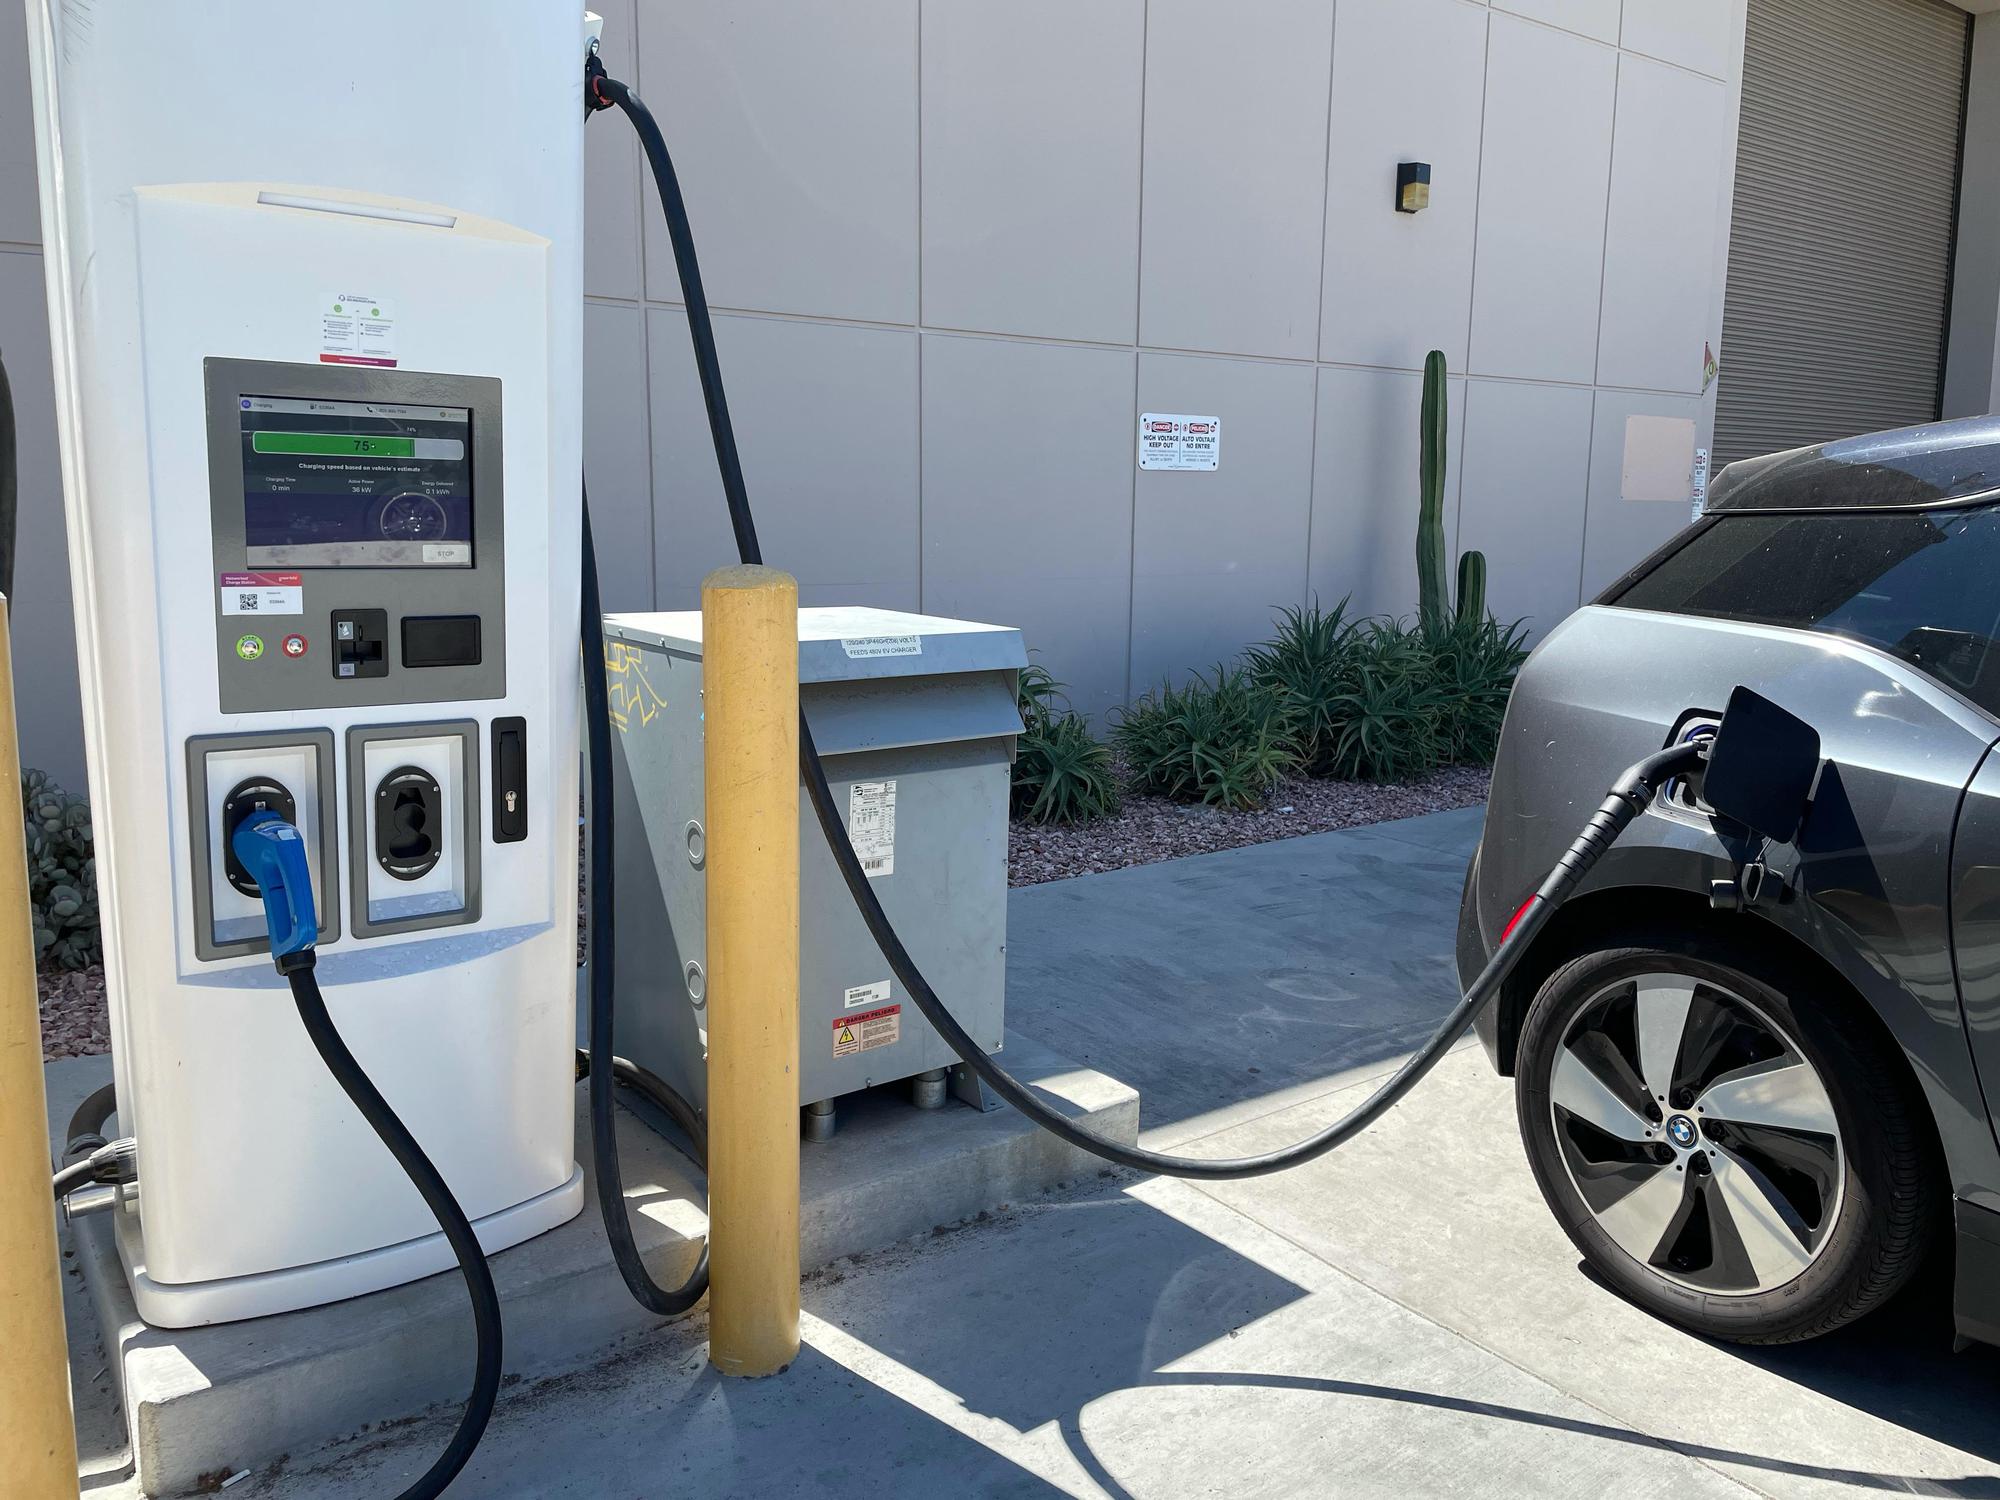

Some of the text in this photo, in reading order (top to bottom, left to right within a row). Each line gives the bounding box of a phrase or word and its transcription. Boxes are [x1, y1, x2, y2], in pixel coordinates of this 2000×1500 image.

[899, 635, 917, 644] VOLTS
[846, 1007, 895, 1024] DANGER PELIGRO
